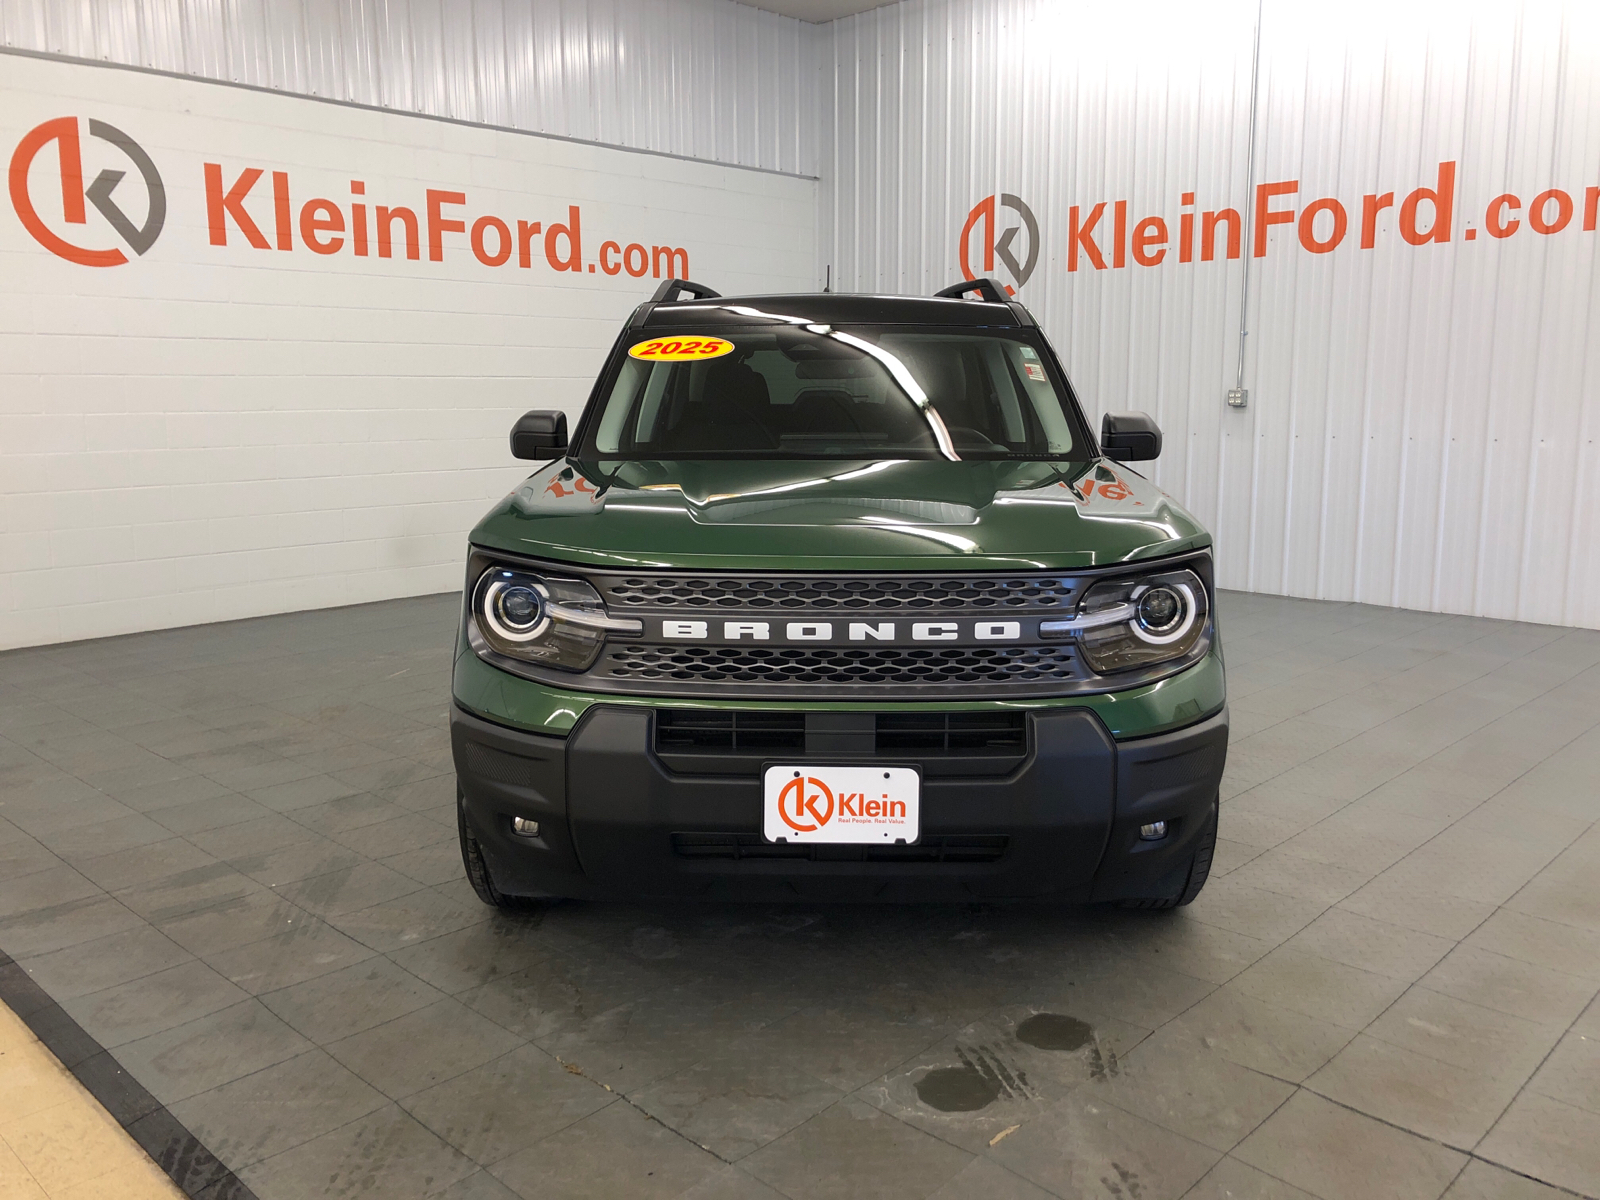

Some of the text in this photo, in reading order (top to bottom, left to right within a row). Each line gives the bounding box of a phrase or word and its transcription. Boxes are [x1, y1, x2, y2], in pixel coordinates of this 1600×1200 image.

[203, 162, 690, 281] KleinFord.com
[1068, 160, 1600, 272] KleinFord.co
[638, 341, 724, 356] 2025
[662, 620, 1021, 641] BRONCO
[838, 793, 906, 818] Klein
